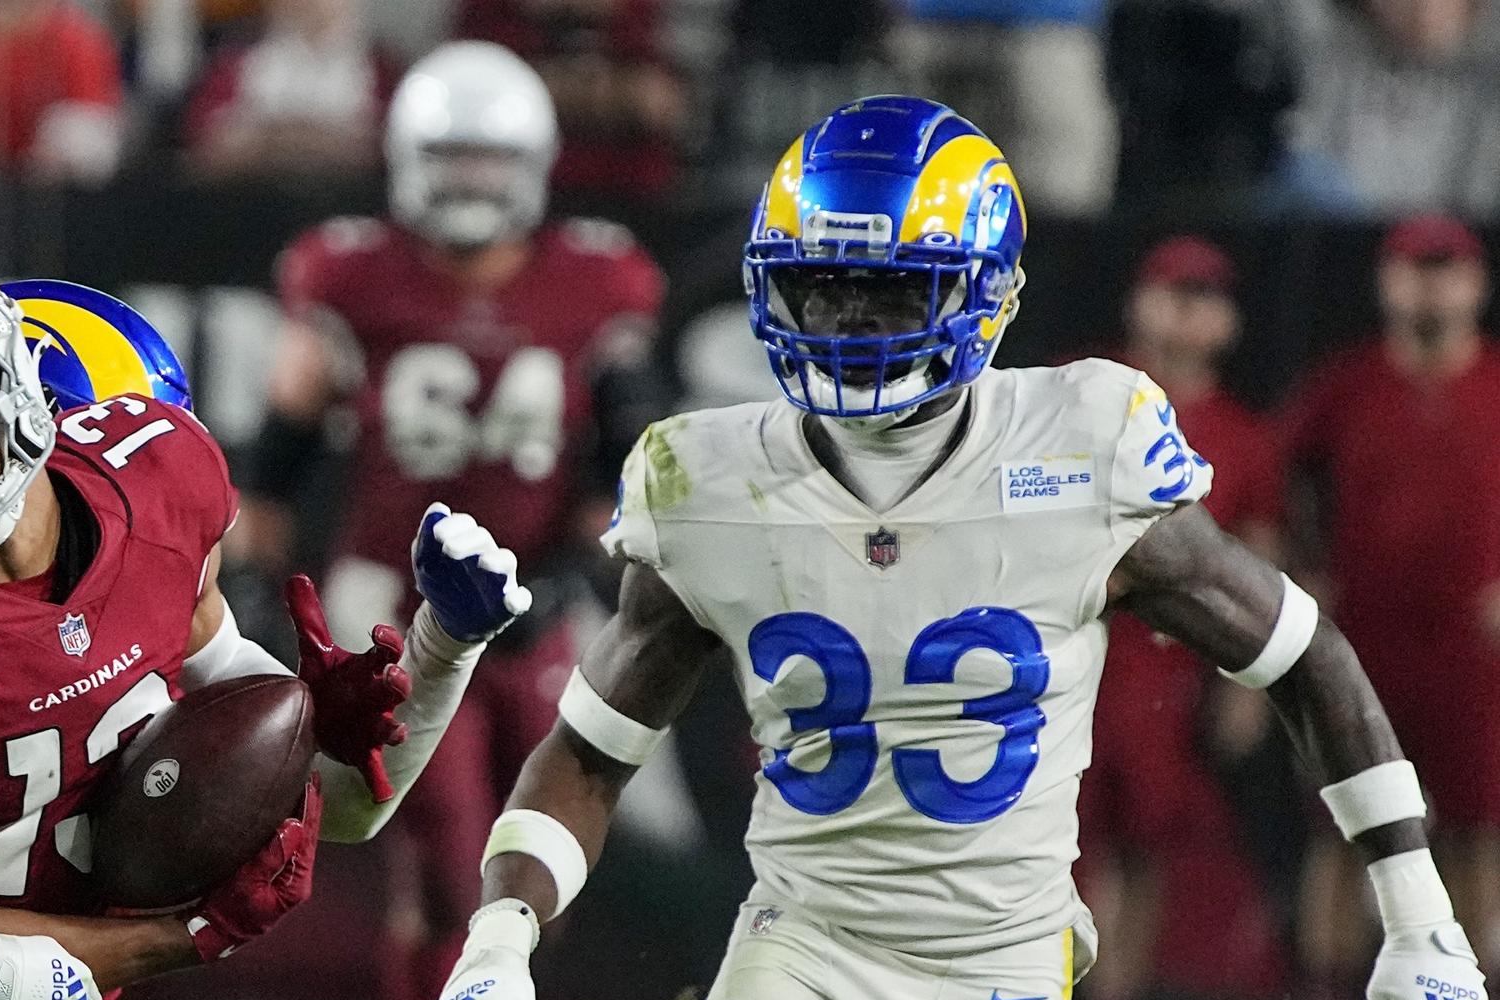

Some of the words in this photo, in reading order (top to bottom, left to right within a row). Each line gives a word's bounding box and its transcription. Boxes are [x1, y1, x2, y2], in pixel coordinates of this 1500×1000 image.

[384, 344, 564, 480] 64
[60, 396, 176, 470] 13
[1009, 465, 1043, 478] LOS
[1009, 472, 1092, 488] ANGELES
[1144, 432, 1209, 502] 3
[1009, 486, 1060, 498] RAMS
[64, 630, 87, 650] NFL
[29, 643, 143, 712] CARDINALS
[747, 606, 1050, 824] 33
[155, 771, 176, 793] 061
[1415, 974, 1479, 1000] adidas
